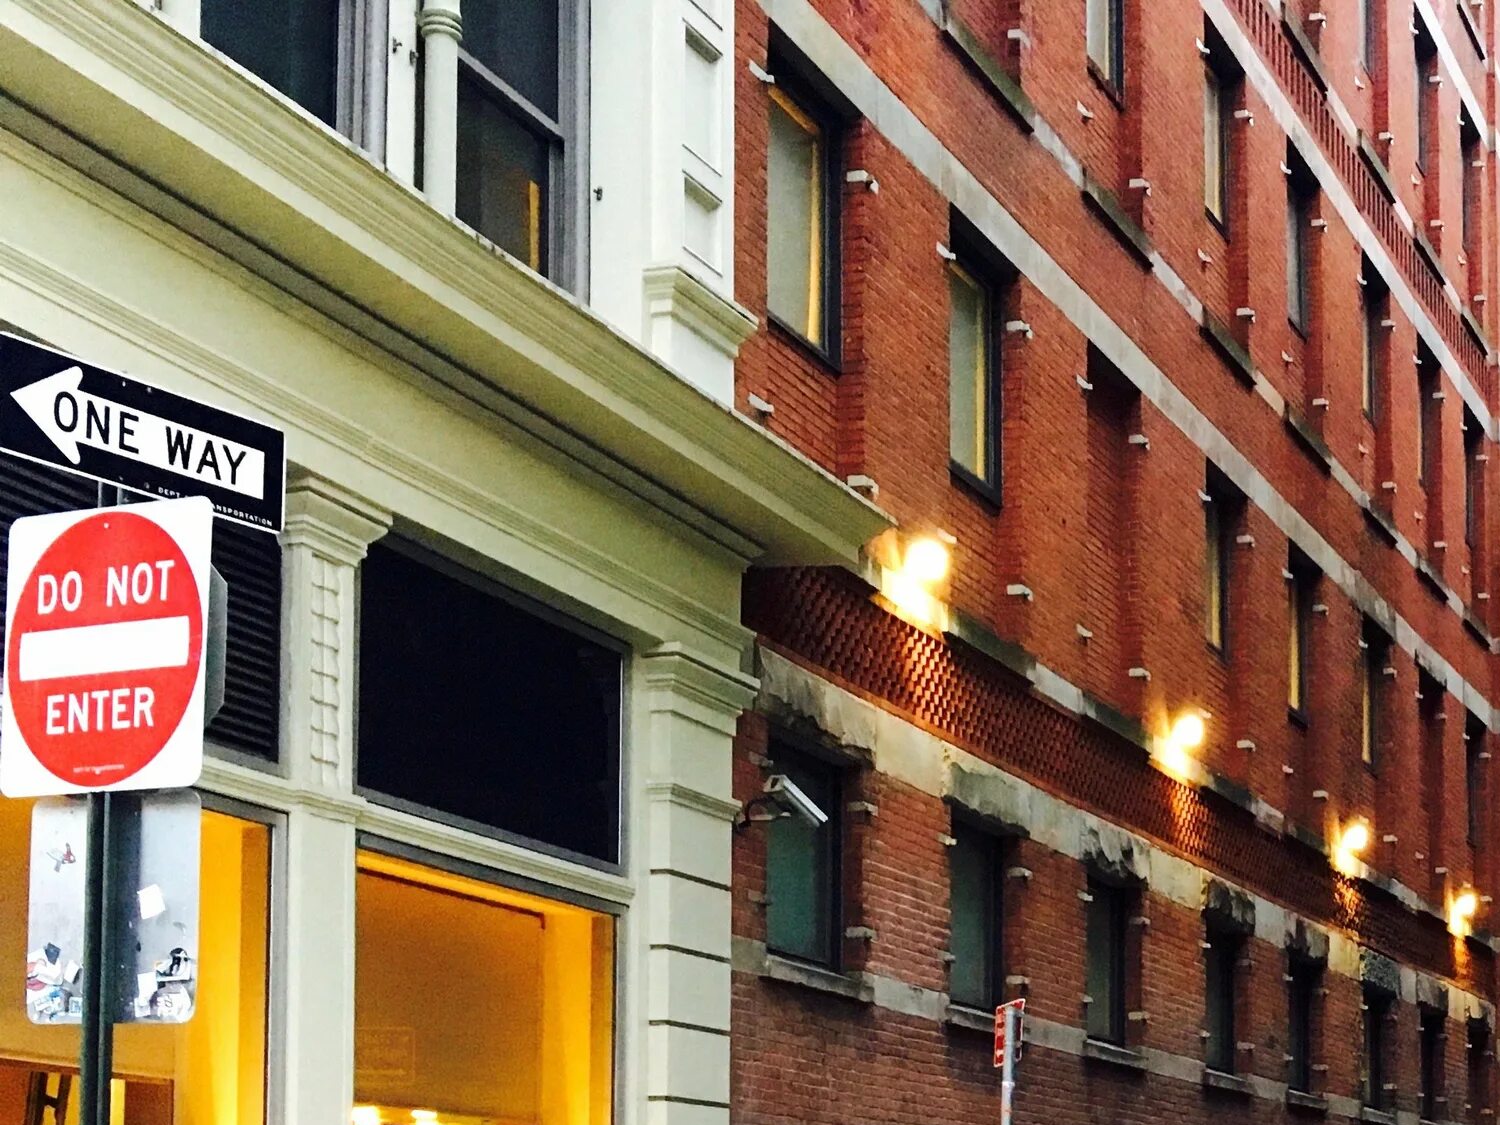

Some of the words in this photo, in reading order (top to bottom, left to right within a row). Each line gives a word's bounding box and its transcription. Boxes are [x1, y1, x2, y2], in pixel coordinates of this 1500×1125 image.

[54, 391, 142, 454] ONE
[165, 425, 247, 485] WAY
[213, 504, 273, 527] NSPORTATION
[37, 569, 82, 615] DO
[106, 560, 175, 607] NOT
[46, 687, 155, 735] ENTER
